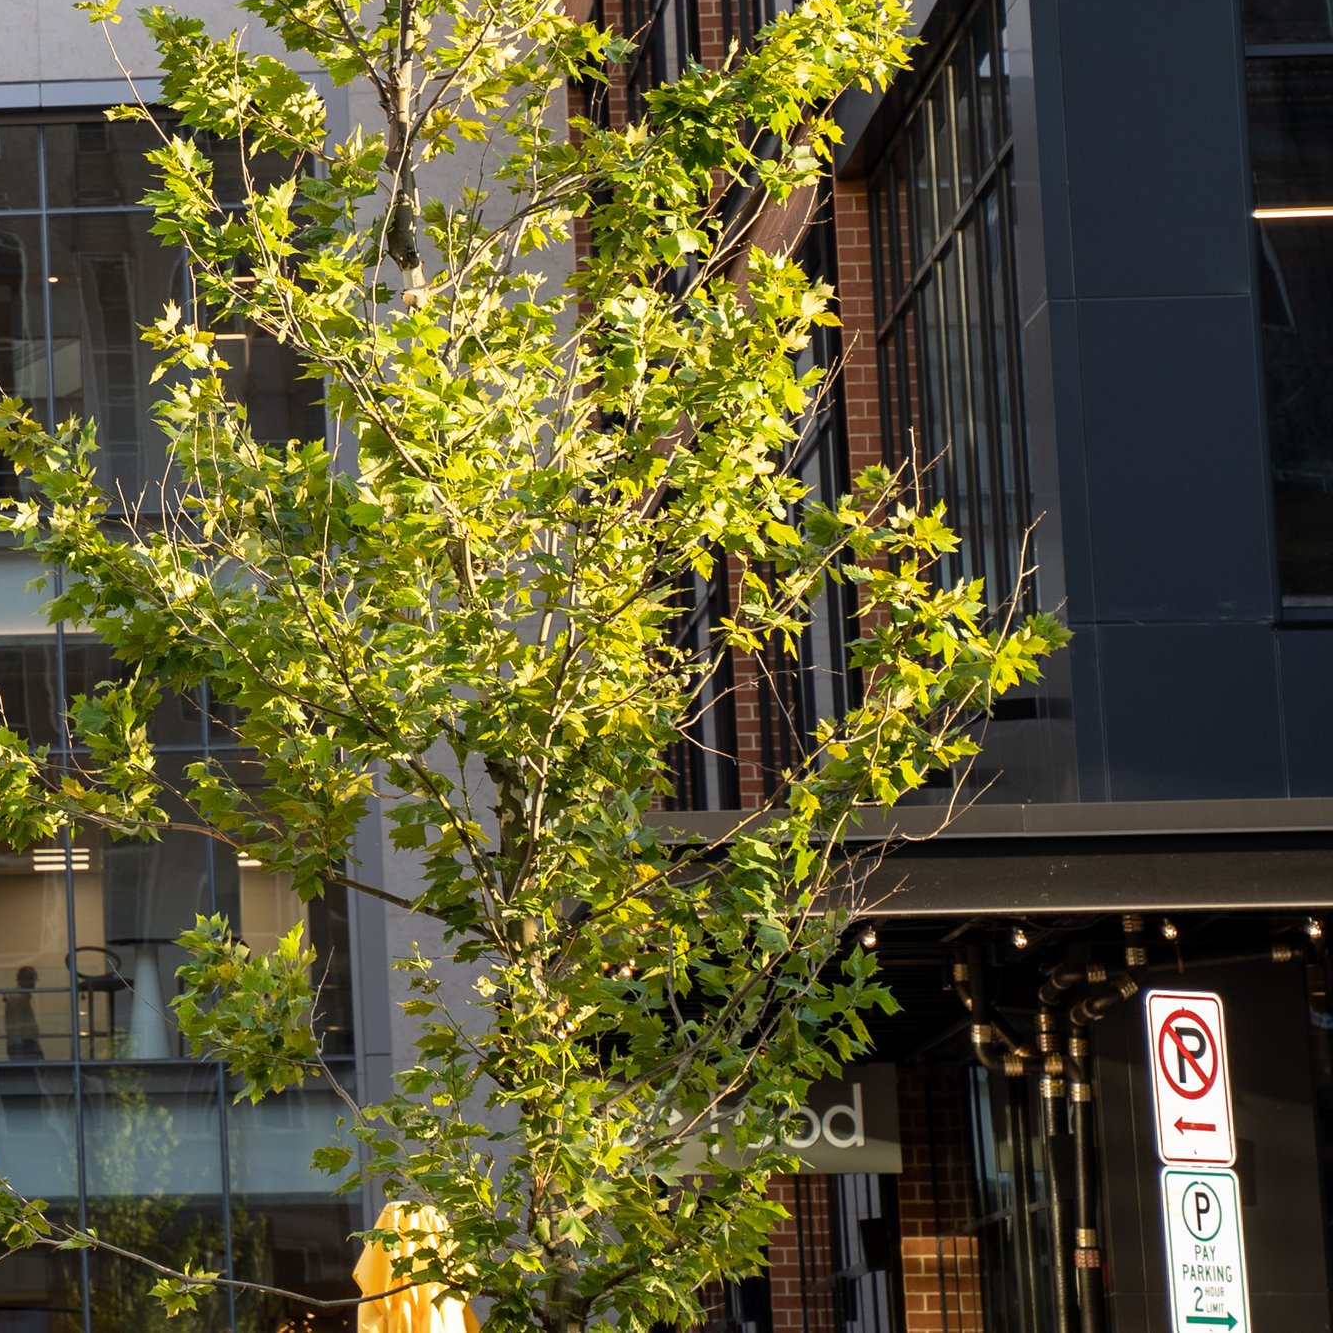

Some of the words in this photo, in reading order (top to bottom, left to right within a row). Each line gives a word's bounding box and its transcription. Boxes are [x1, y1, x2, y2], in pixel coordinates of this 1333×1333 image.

[1194, 1191, 1211, 1232] P
[1194, 1244, 1216, 1262] PAY
[1182, 1264, 1233, 1283] PARKING
[1193, 1286, 1204, 1312] 2
[1205, 1286, 1225, 1298] HOUR
[1206, 1303, 1225, 1314] LIMIT
